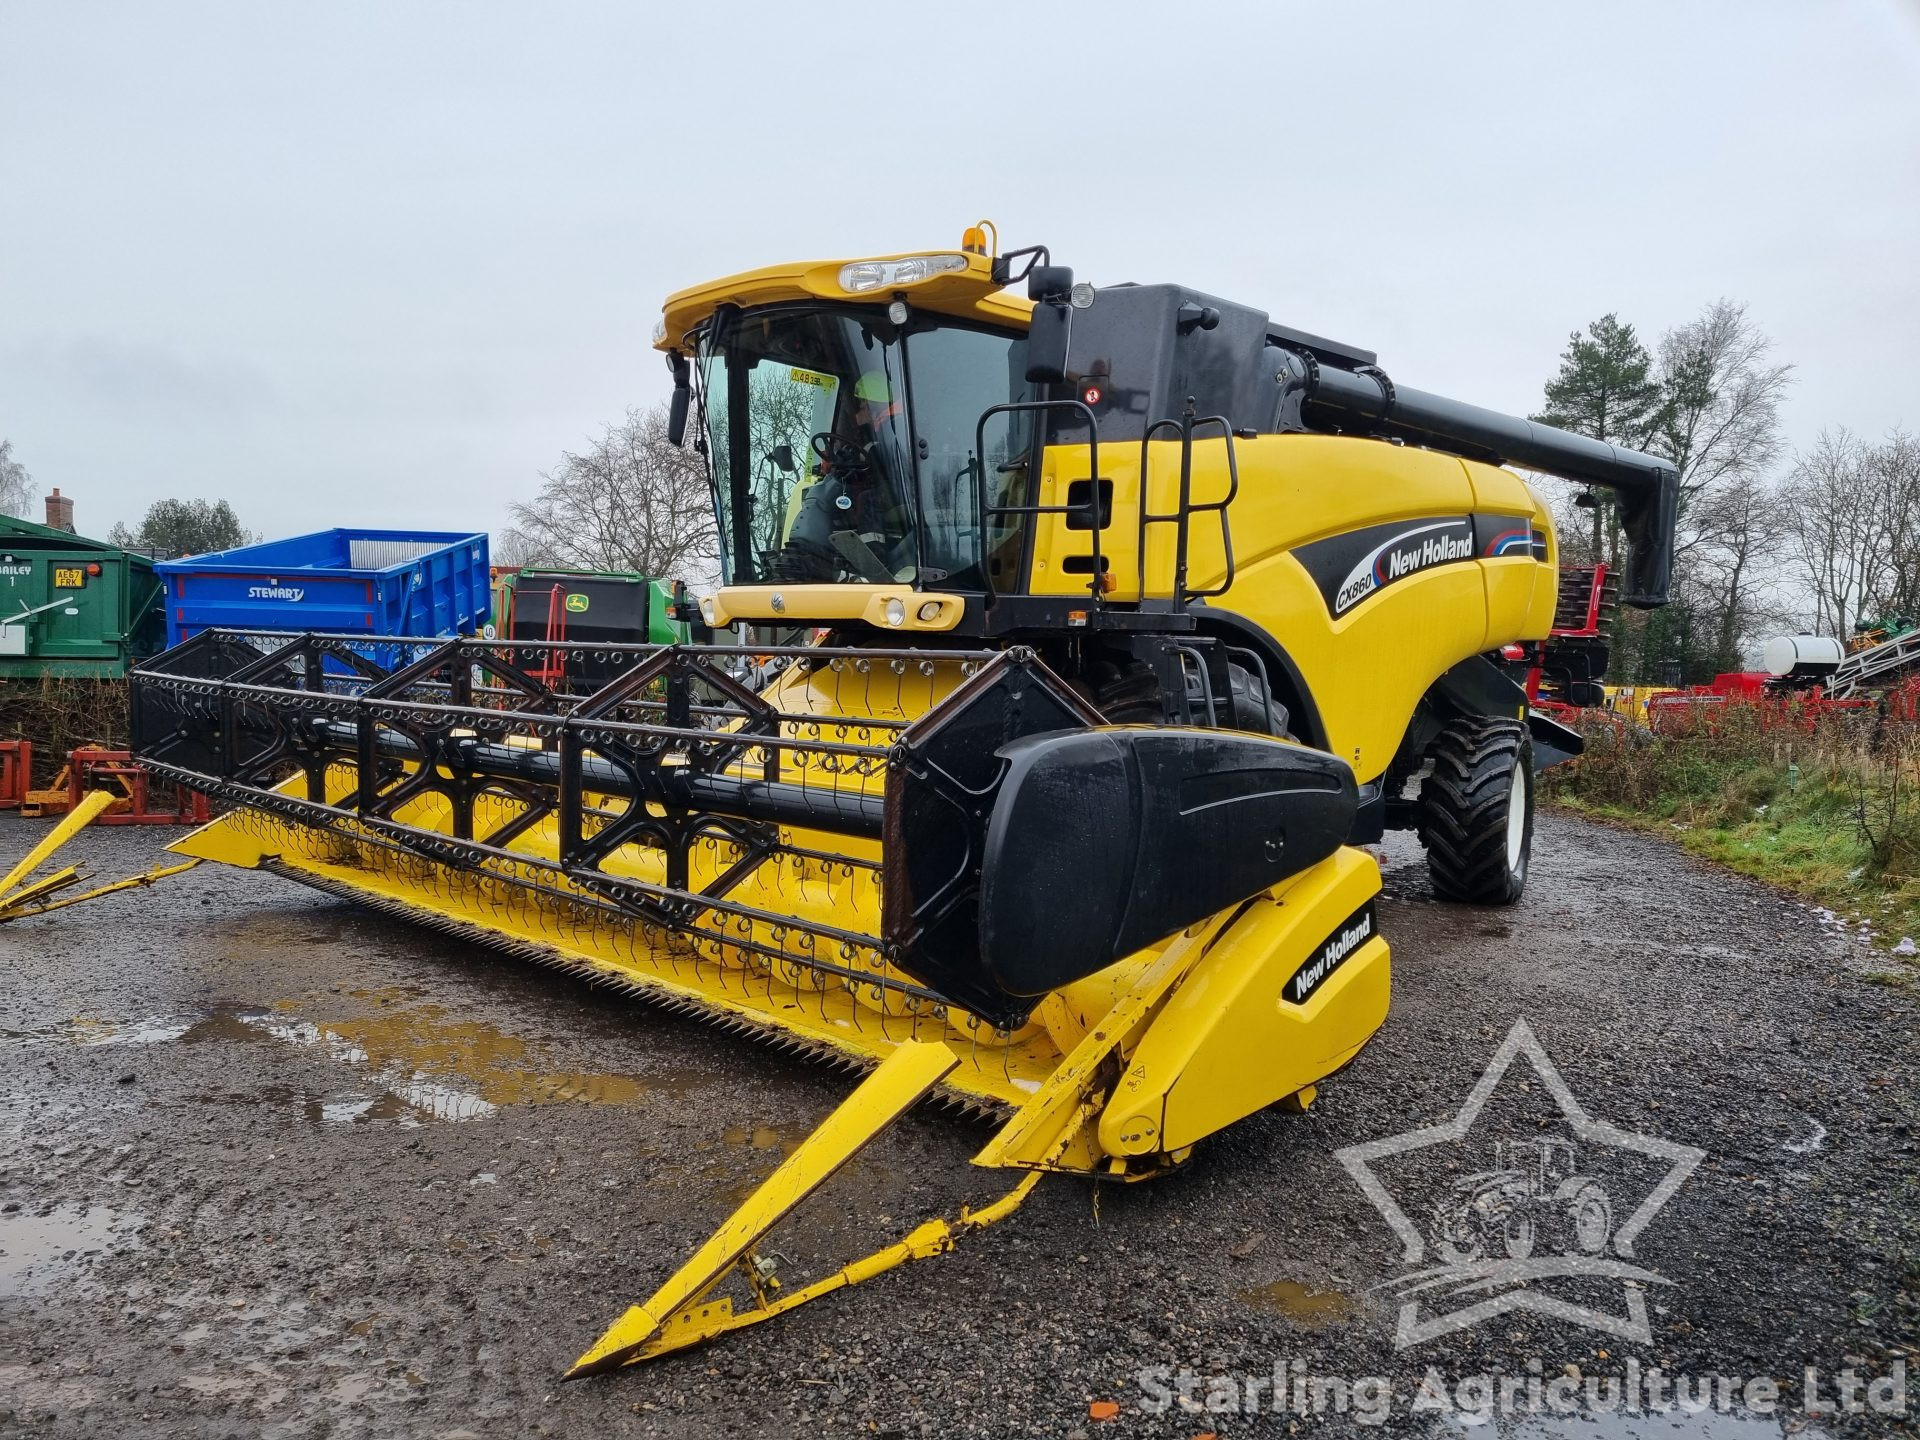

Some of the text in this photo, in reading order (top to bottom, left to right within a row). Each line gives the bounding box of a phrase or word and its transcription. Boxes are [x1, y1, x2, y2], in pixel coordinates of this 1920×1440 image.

[1389, 532, 1473, 579] New Holland
[58, 571, 80, 579] AE67
[1337, 573, 1372, 609] CX860
[248, 587, 304, 602] STEWART
[1296, 913, 1371, 1000] New Holland
